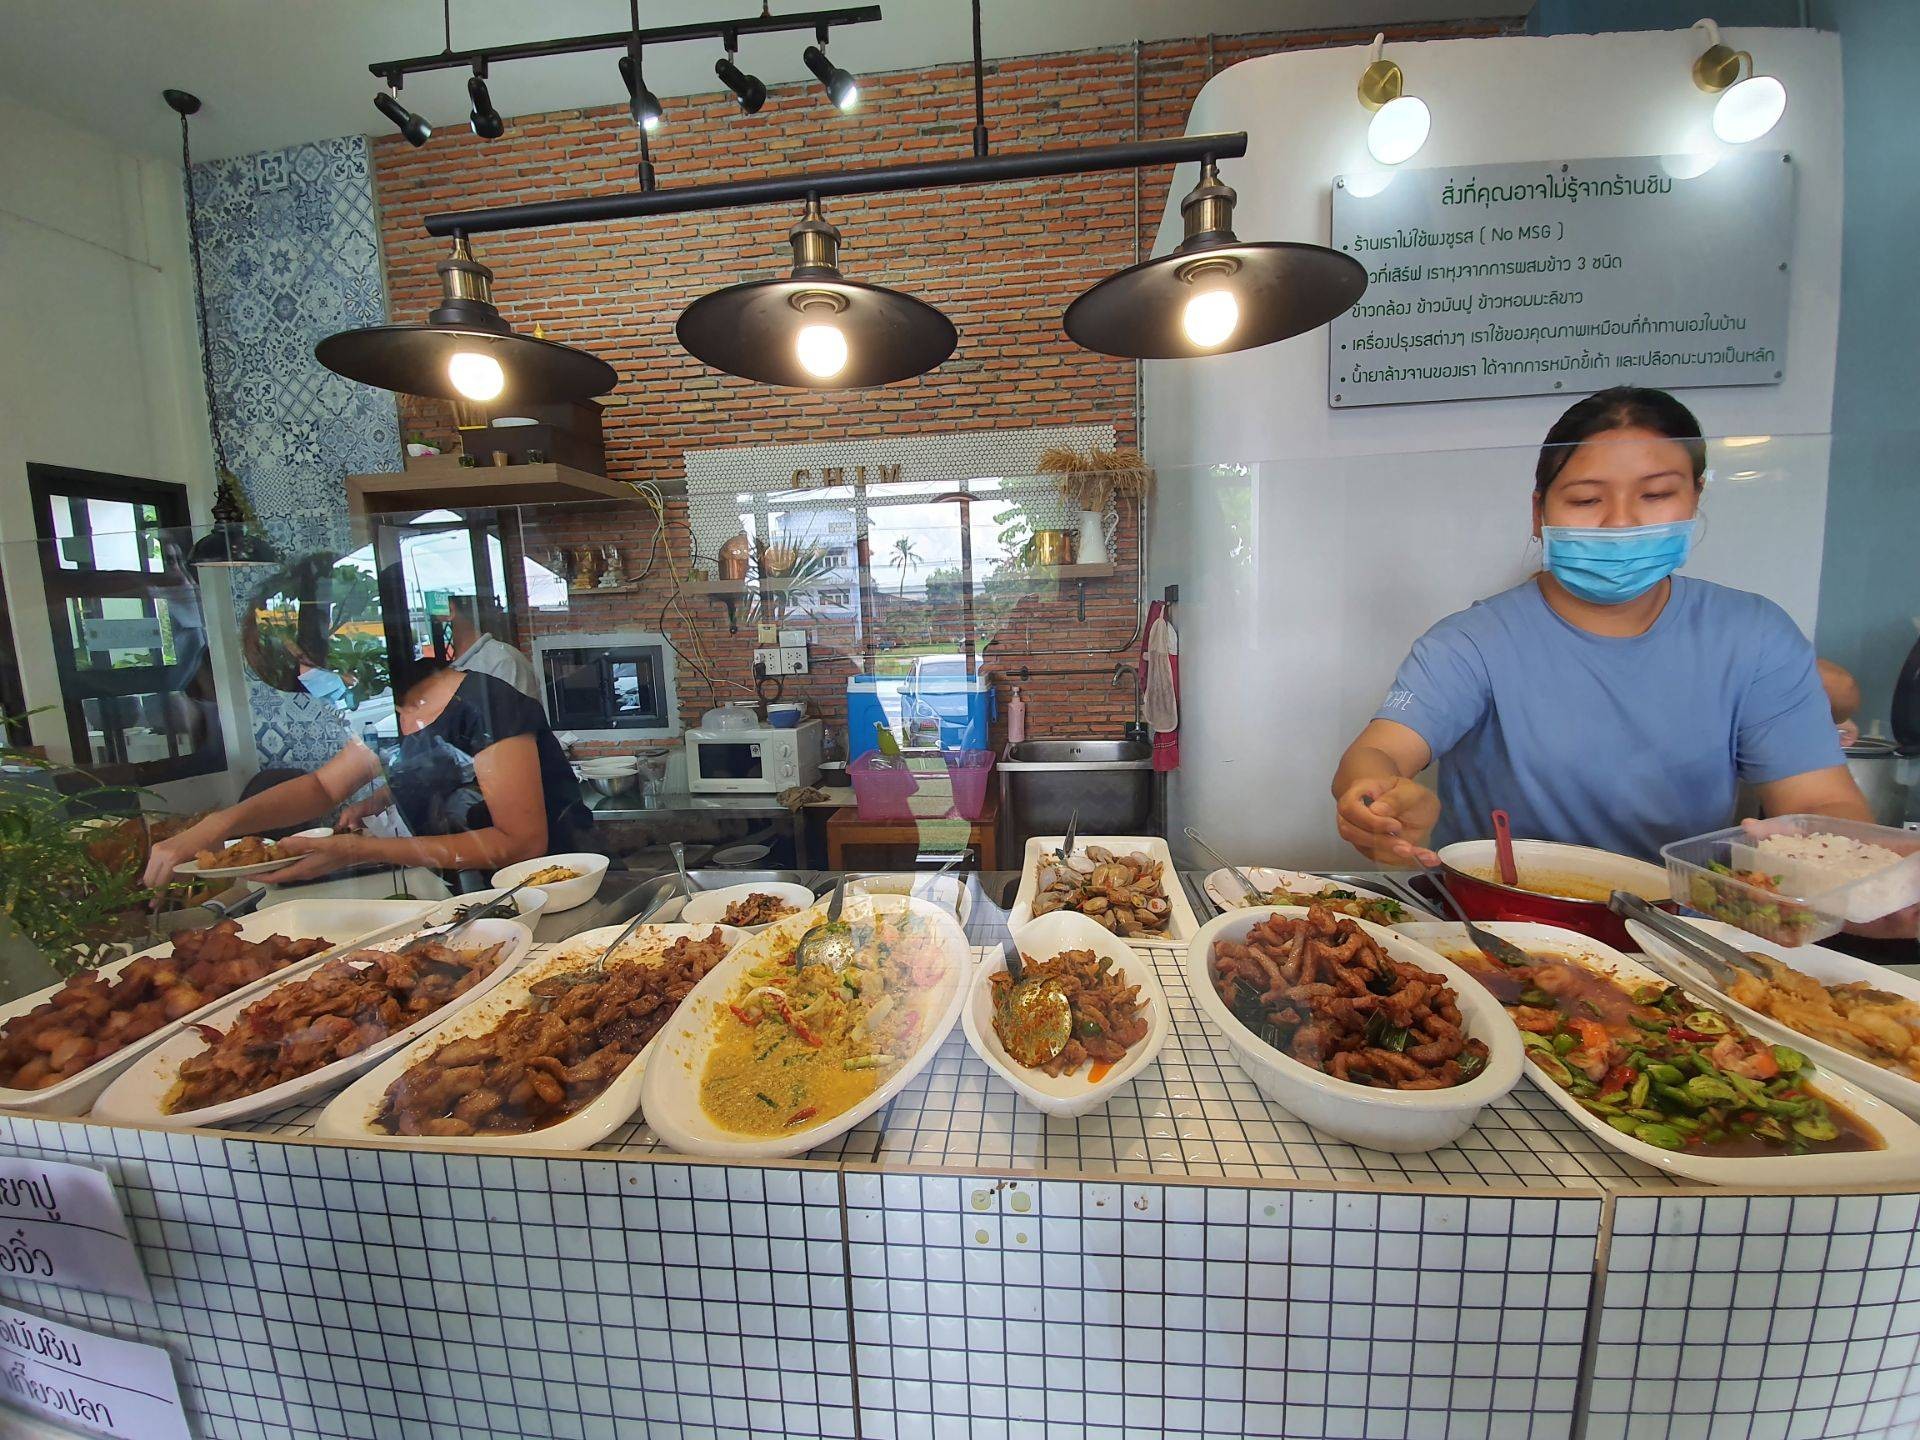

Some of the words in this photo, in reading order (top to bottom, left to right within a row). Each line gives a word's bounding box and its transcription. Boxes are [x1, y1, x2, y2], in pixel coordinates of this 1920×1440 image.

[1491, 227, 1513, 242] No
[1518, 225, 1551, 241] MSG
[1370, 263, 1422, 284] วที่เสิร์ฟ
[1577, 257, 1586, 271] 3
[1592, 254, 1622, 270] ชนิด
[791, 464, 901, 489] CHIM
[0, 1174, 61, 1221] ยาปู
